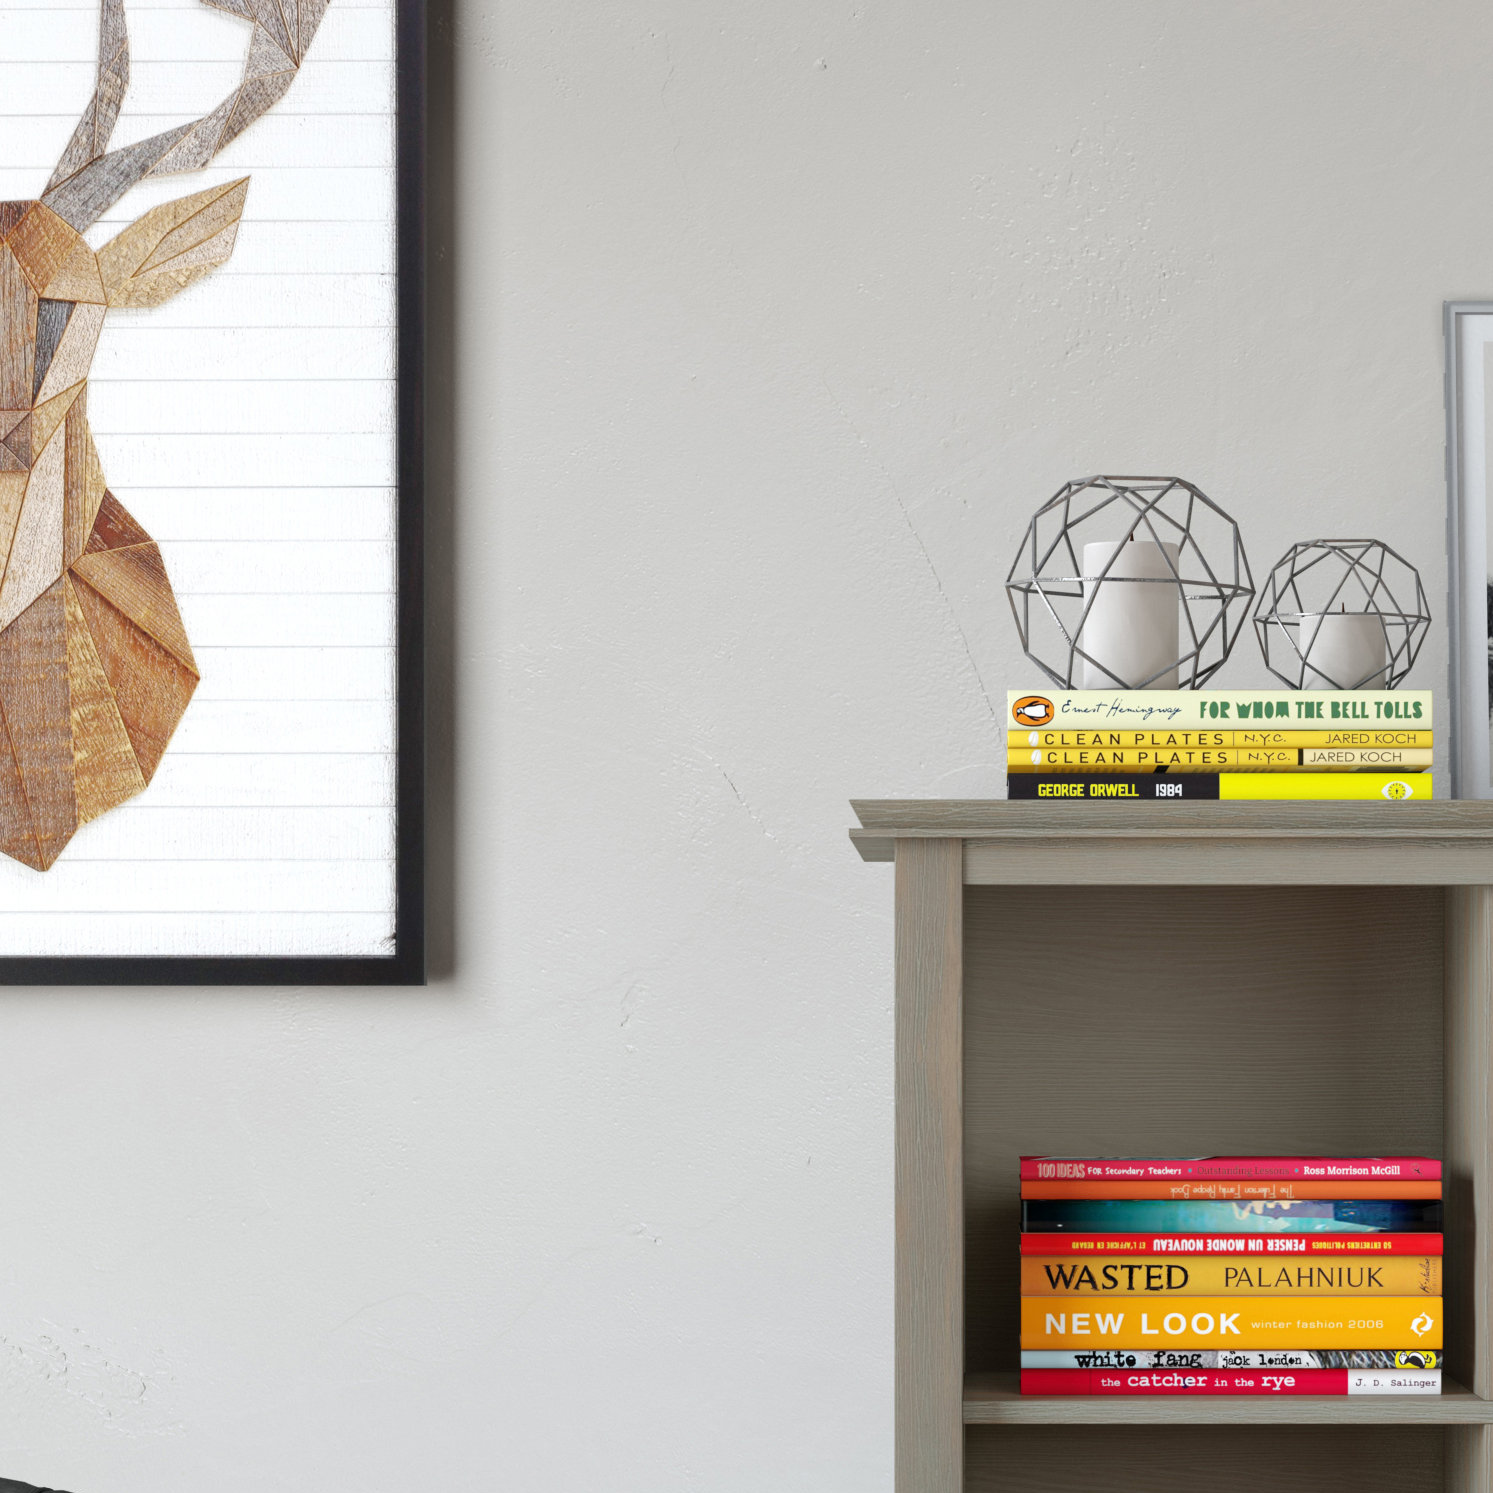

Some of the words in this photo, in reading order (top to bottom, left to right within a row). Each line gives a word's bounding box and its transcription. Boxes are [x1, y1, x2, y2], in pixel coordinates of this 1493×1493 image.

[1061, 699, 1108, 714] Ernest
[1106, 697, 1182, 720] Hemingway
[1200, 701, 1230, 719] FOR
[1236, 701, 1290, 719] WHOM
[1295, 701, 1324, 719] THE
[1331, 701, 1369, 719] BELL
[1374, 701, 1423, 719] TOLLS
[1044, 733, 1121, 745] CLEAN
[1134, 733, 1224, 745] PLATES
[1244, 733, 1287, 746] N.Y.C.
[1325, 733, 1370, 744] JARED
[1375, 733, 1417, 744] KOCH
[1047, 751, 1124, 764] CLEAN
[1138, 751, 1227, 764] PLATES
[1248, 752, 1291, 764] N.Y.C.
[1310, 751, 1355, 762] JARED
[1360, 751, 1402, 762] KOCH
[1038, 783, 1085, 797] GEORGE
[1090, 783, 1139, 797] ORWELL
[1155, 783, 1183, 797] 1984
[1037, 1163, 1055, 1178] 100
[1056, 1163, 1085, 1178] IDEAS
[1087, 1167, 1103, 1175] FOR
[1105, 1167, 1144, 1177] Secondary
[1148, 1166, 1182, 1175] Teachers
[1254, 1166, 1289, 1175] Lessons
[1303, 1166, 1325, 1175] Ross
[1327, 1166, 1369, 1175] Morrison
[1371, 1166, 1400, 1175] McGill
[1153, 1238, 1204, 1251] NOUVEAU
[1207, 1238, 1245, 1251] MONDE
[1248, 1238, 1263, 1251] UN
[1267, 1238, 1306, 1251] PENSER
[1042, 1264, 1189, 1291] WASTED
[1225, 1267, 1384, 1288] PALAHNIUK
[1045, 1313, 1125, 1335] NEW
[1141, 1313, 1241, 1335] LOOK
[1251, 1319, 1292, 1329] winter
[1296, 1319, 1343, 1329] fashion
[1348, 1319, 1384, 1329] 2006
[1074, 1351, 1137, 1368] white
[1152, 1351, 1203, 1369] fang
[1258, 1353, 1302, 1366] london
[1101, 1378, 1121, 1387] the
[1127, 1373, 1208, 1387] catcher
[1214, 1378, 1228, 1387] in
[1234, 1378, 1254, 1387] the
[1261, 1375, 1296, 1391] rye
[1355, 1378, 1367, 1387] J.
[1373, 1378, 1384, 1387] D.
[1390, 1378, 1437, 1389] Salinger
